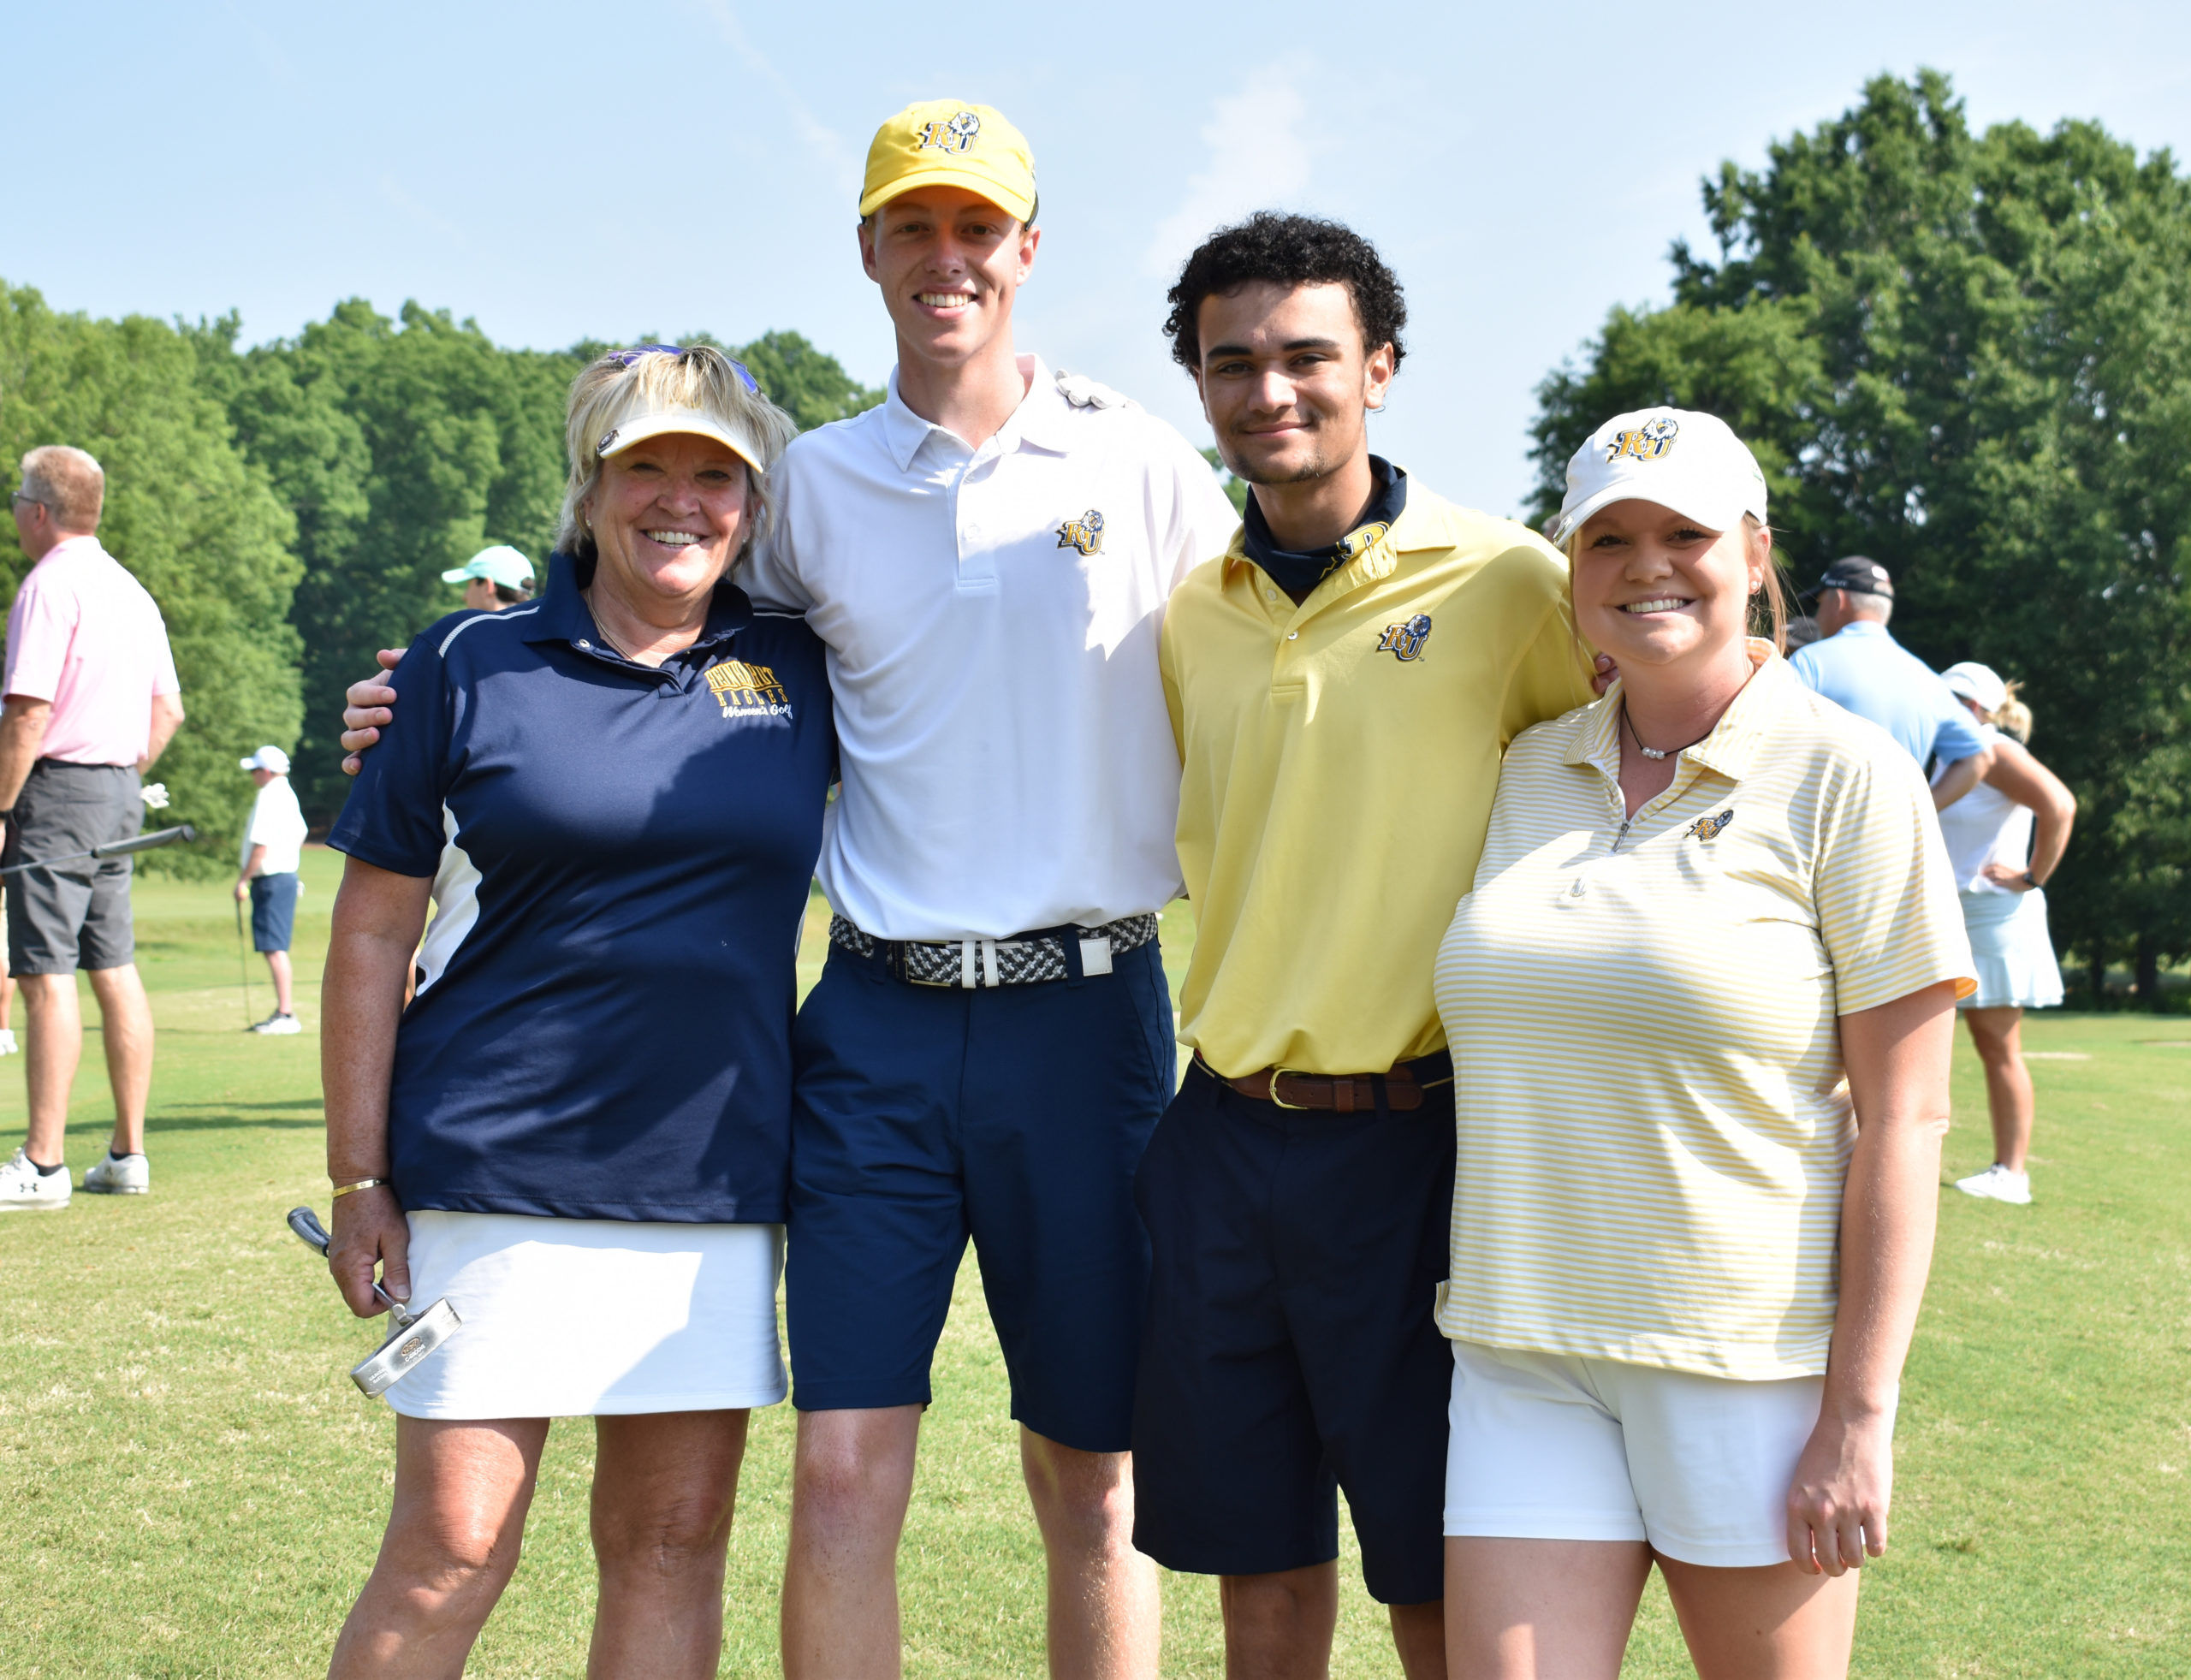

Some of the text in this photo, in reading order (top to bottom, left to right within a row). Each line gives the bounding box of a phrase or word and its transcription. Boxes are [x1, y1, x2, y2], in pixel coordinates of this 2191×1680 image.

[919, 122, 977, 154] RU
[1607, 429, 1677, 463] RU
[1055, 519, 1104, 556] RU
[1376, 625, 1428, 662] RU
[714, 688, 788, 707] EAGLES
[722, 703, 793, 720] Women's Golf
